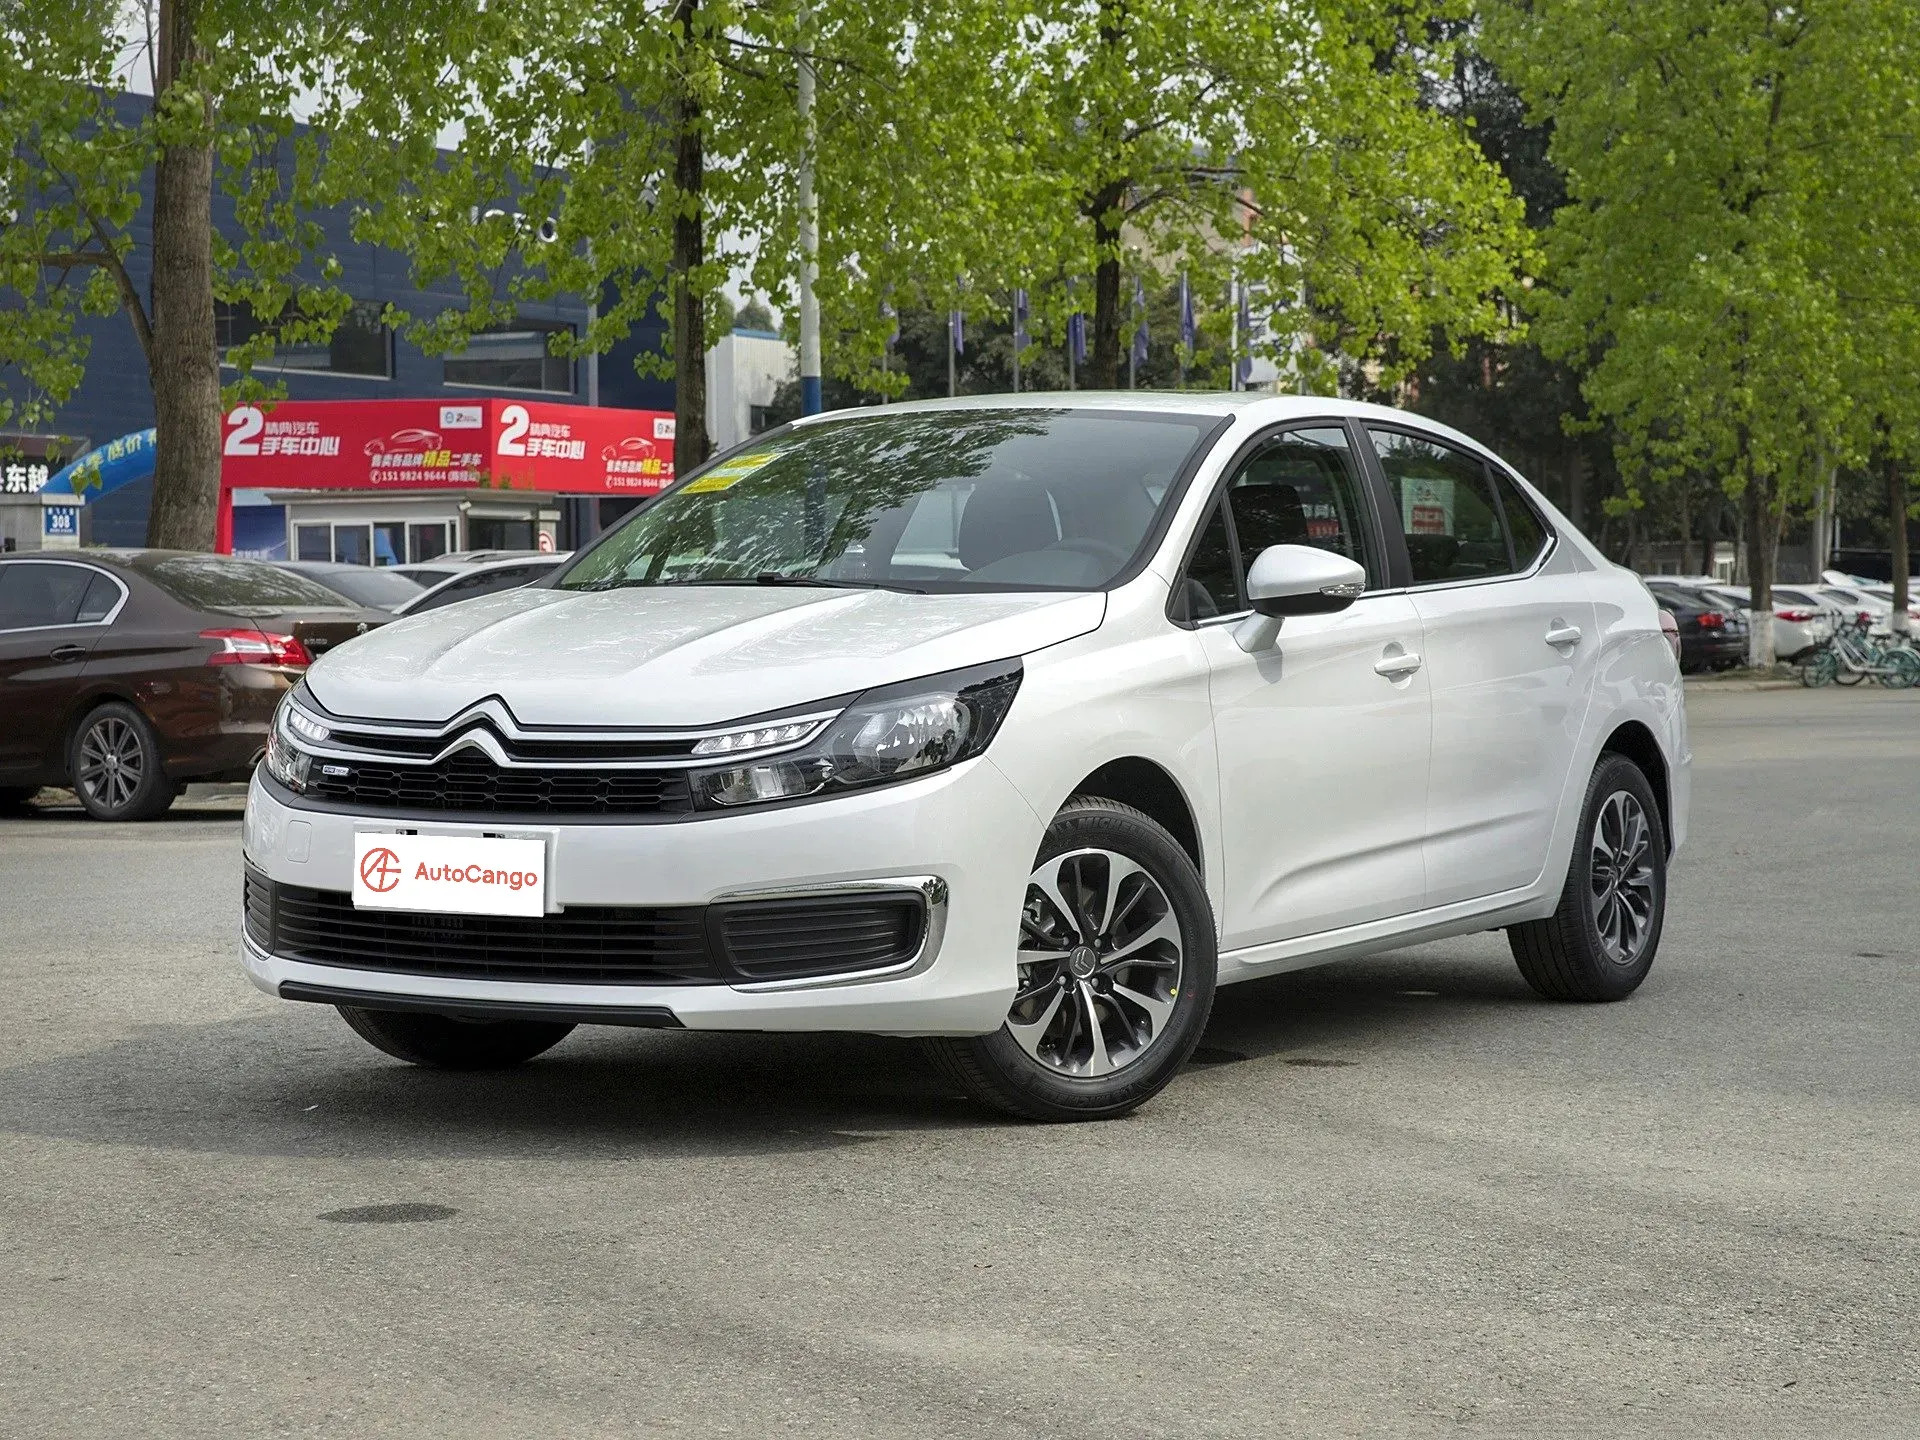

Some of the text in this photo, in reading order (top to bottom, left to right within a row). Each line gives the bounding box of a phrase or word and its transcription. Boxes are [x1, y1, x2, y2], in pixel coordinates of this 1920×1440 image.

[224, 407, 264, 456] 2
[498, 405, 529, 457] 2
[261, 437, 340, 456] 手车中心
[526, 438, 586, 460] 手车中心
[52, 515, 70, 528] 308
